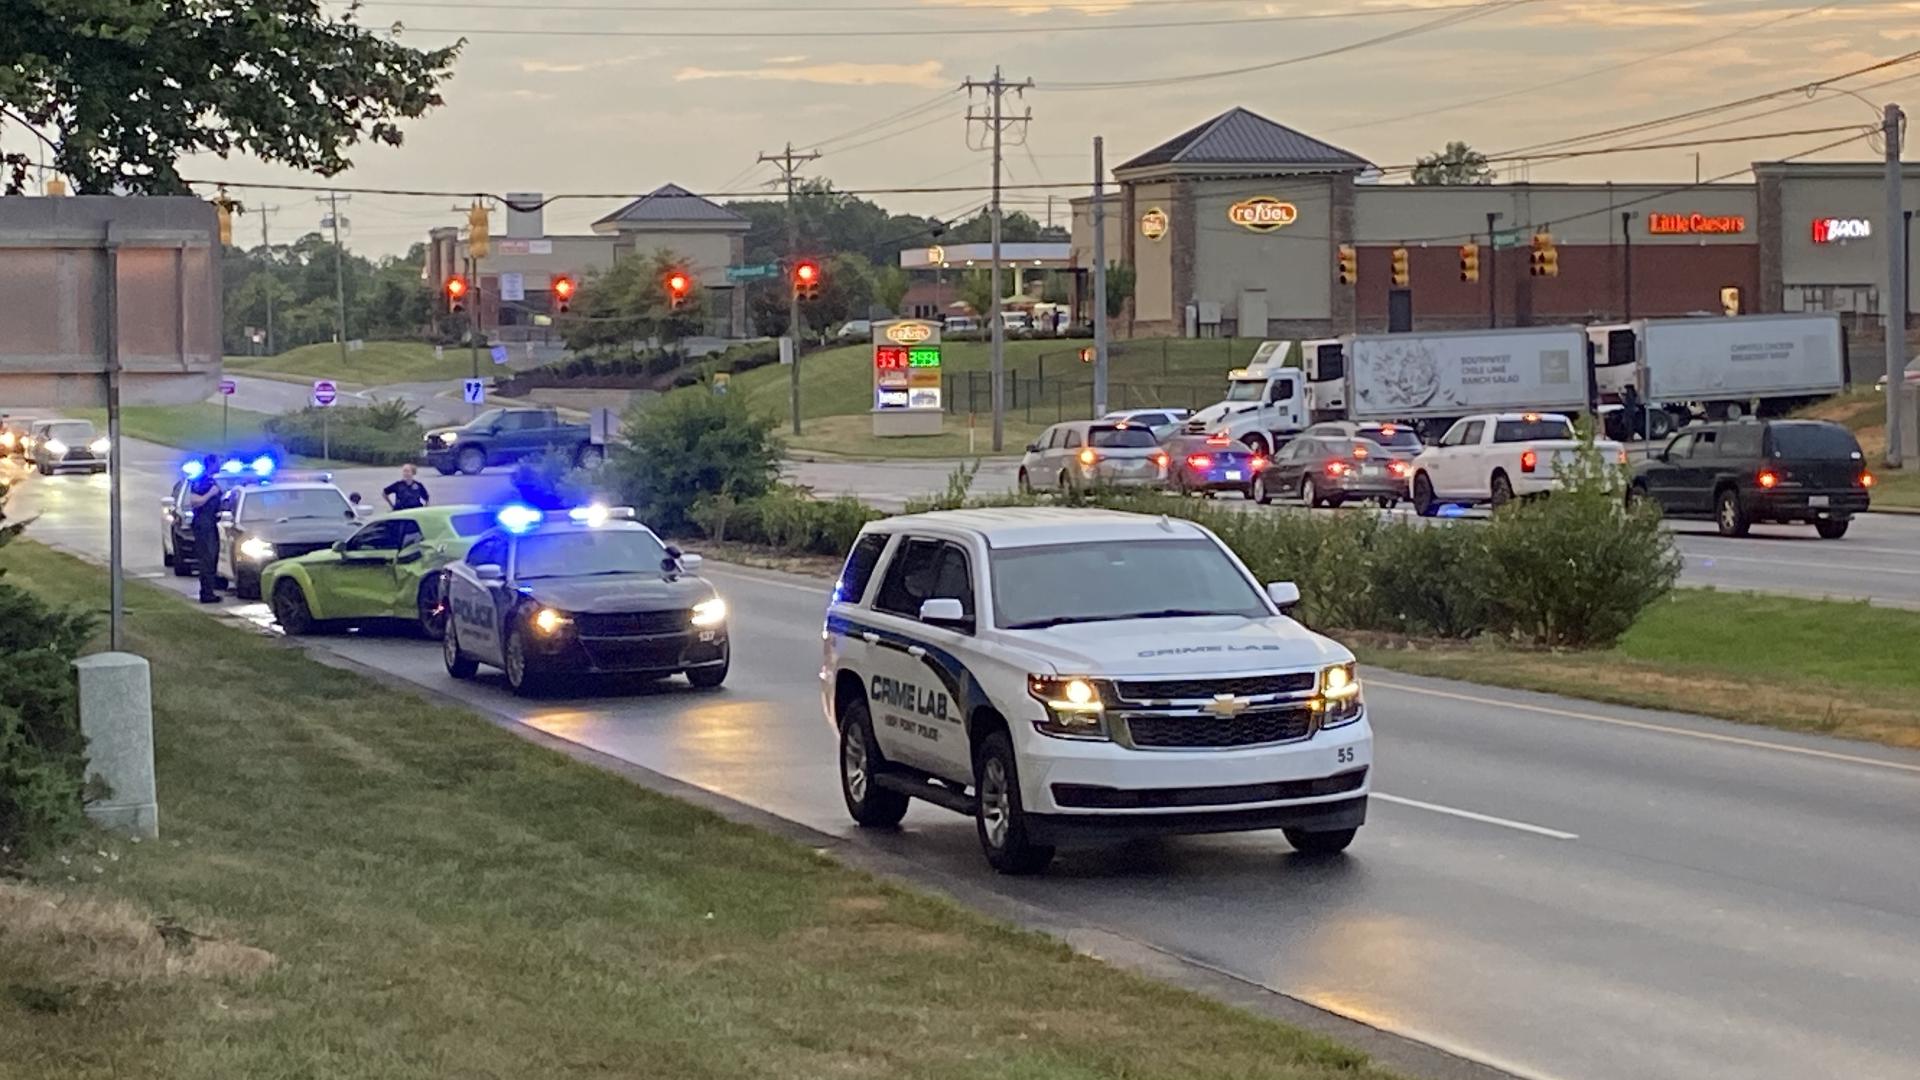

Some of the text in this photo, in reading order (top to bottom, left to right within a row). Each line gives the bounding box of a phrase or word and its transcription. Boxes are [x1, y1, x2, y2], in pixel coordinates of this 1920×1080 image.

[1650, 212, 1745, 233] Little Caesars
[1461, 355, 1511, 365] SOUTHWEST
[1461, 375, 1520, 385] RANCH SALAD
[453, 597, 494, 629] POLICE
[1138, 645, 1222, 657] CRIME
[871, 674, 947, 721] CRIME LAB
[918, 723, 939, 742] POLICE
[1337, 747, 1354, 763] 55
